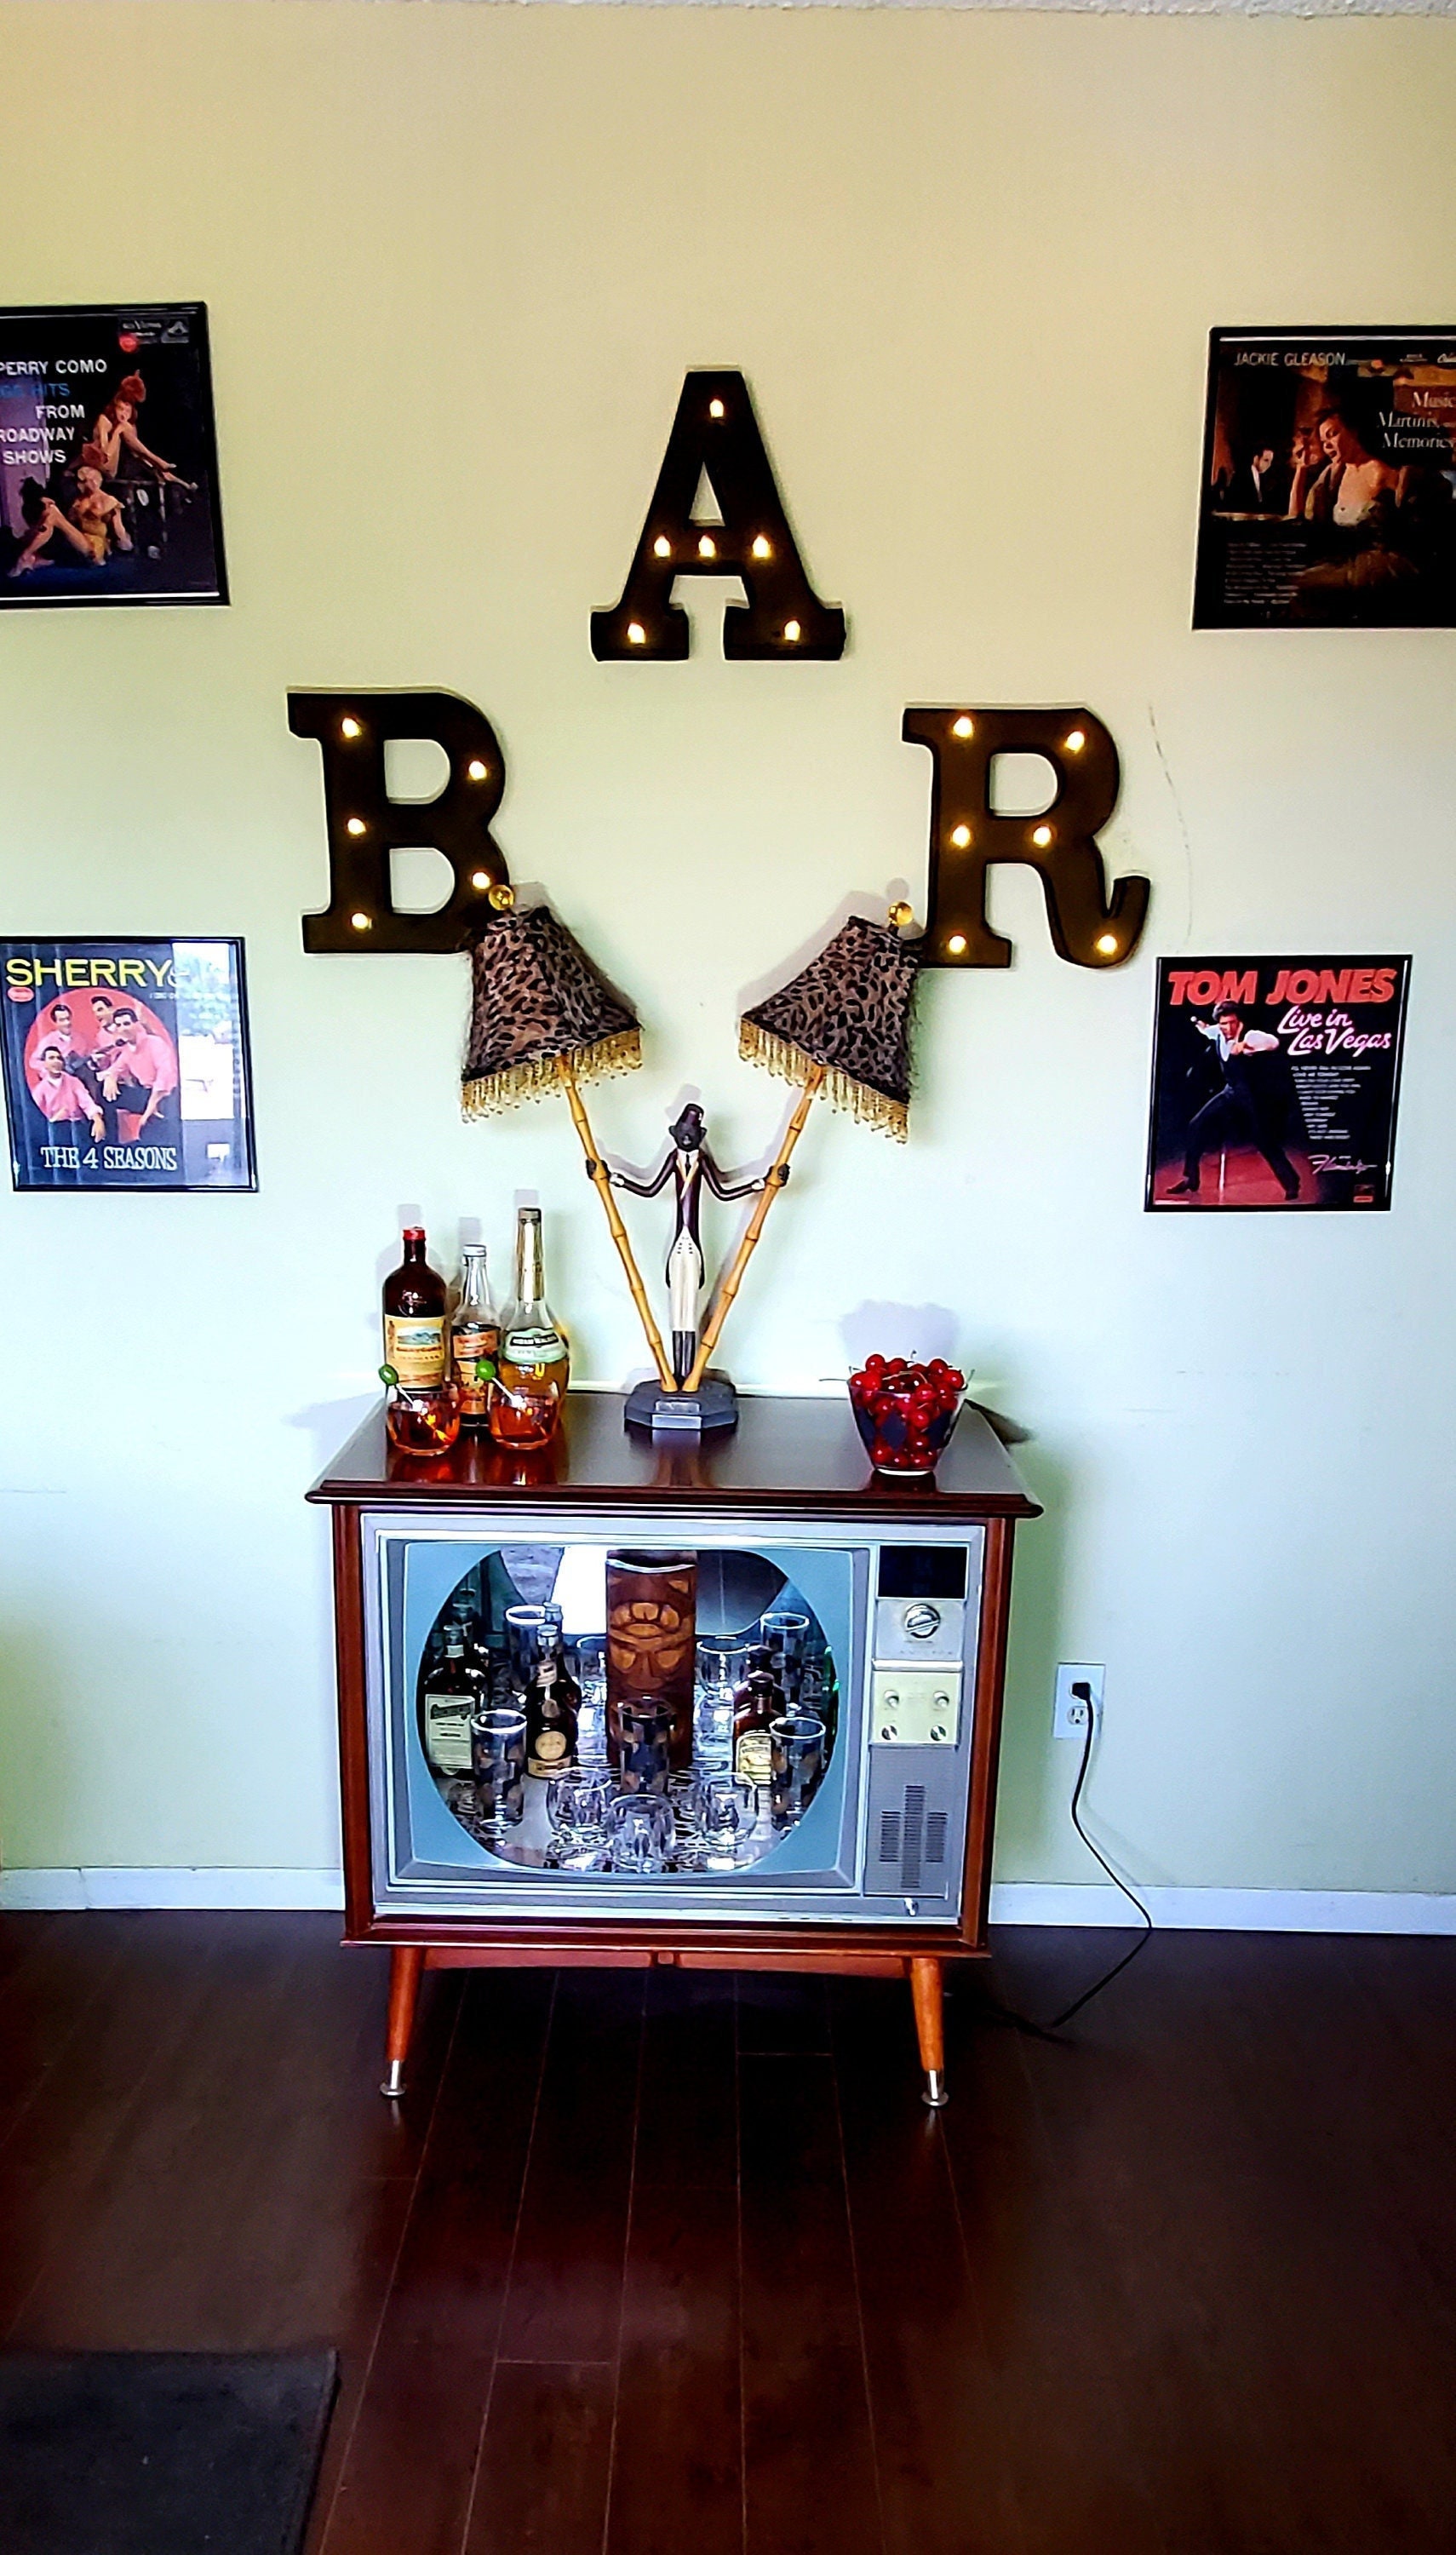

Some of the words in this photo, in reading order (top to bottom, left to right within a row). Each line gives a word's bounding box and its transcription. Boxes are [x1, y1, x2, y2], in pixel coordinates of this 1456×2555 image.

[54, 359, 107, 374] COMO
[1234, 352, 1279, 366] JACKIE
[1284, 352, 1345, 367] GLEASON
[31, 382, 71, 397] HITS
[35, 404, 85, 419] FROM
[2, 449, 66, 465] SHOWS
[589, 365, 847, 662] A
[286, 686, 511, 954] B
[902, 703, 1150, 968] R
[5, 958, 173, 988] SHERRY
[1168, 970, 1258, 1005] TOM
[1265, 967, 1397, 1005] JONES
[1277, 1005, 1322, 1034] Live
[1326, 1008, 1353, 1027] in
[1287, 1027, 1324, 1055] Las
[1324, 1026, 1392, 1057] Vegas
[40, 1146, 81, 1168] THE
[83, 1147, 100, 1169] 4
[103, 1145, 178, 1171] SEASONS
